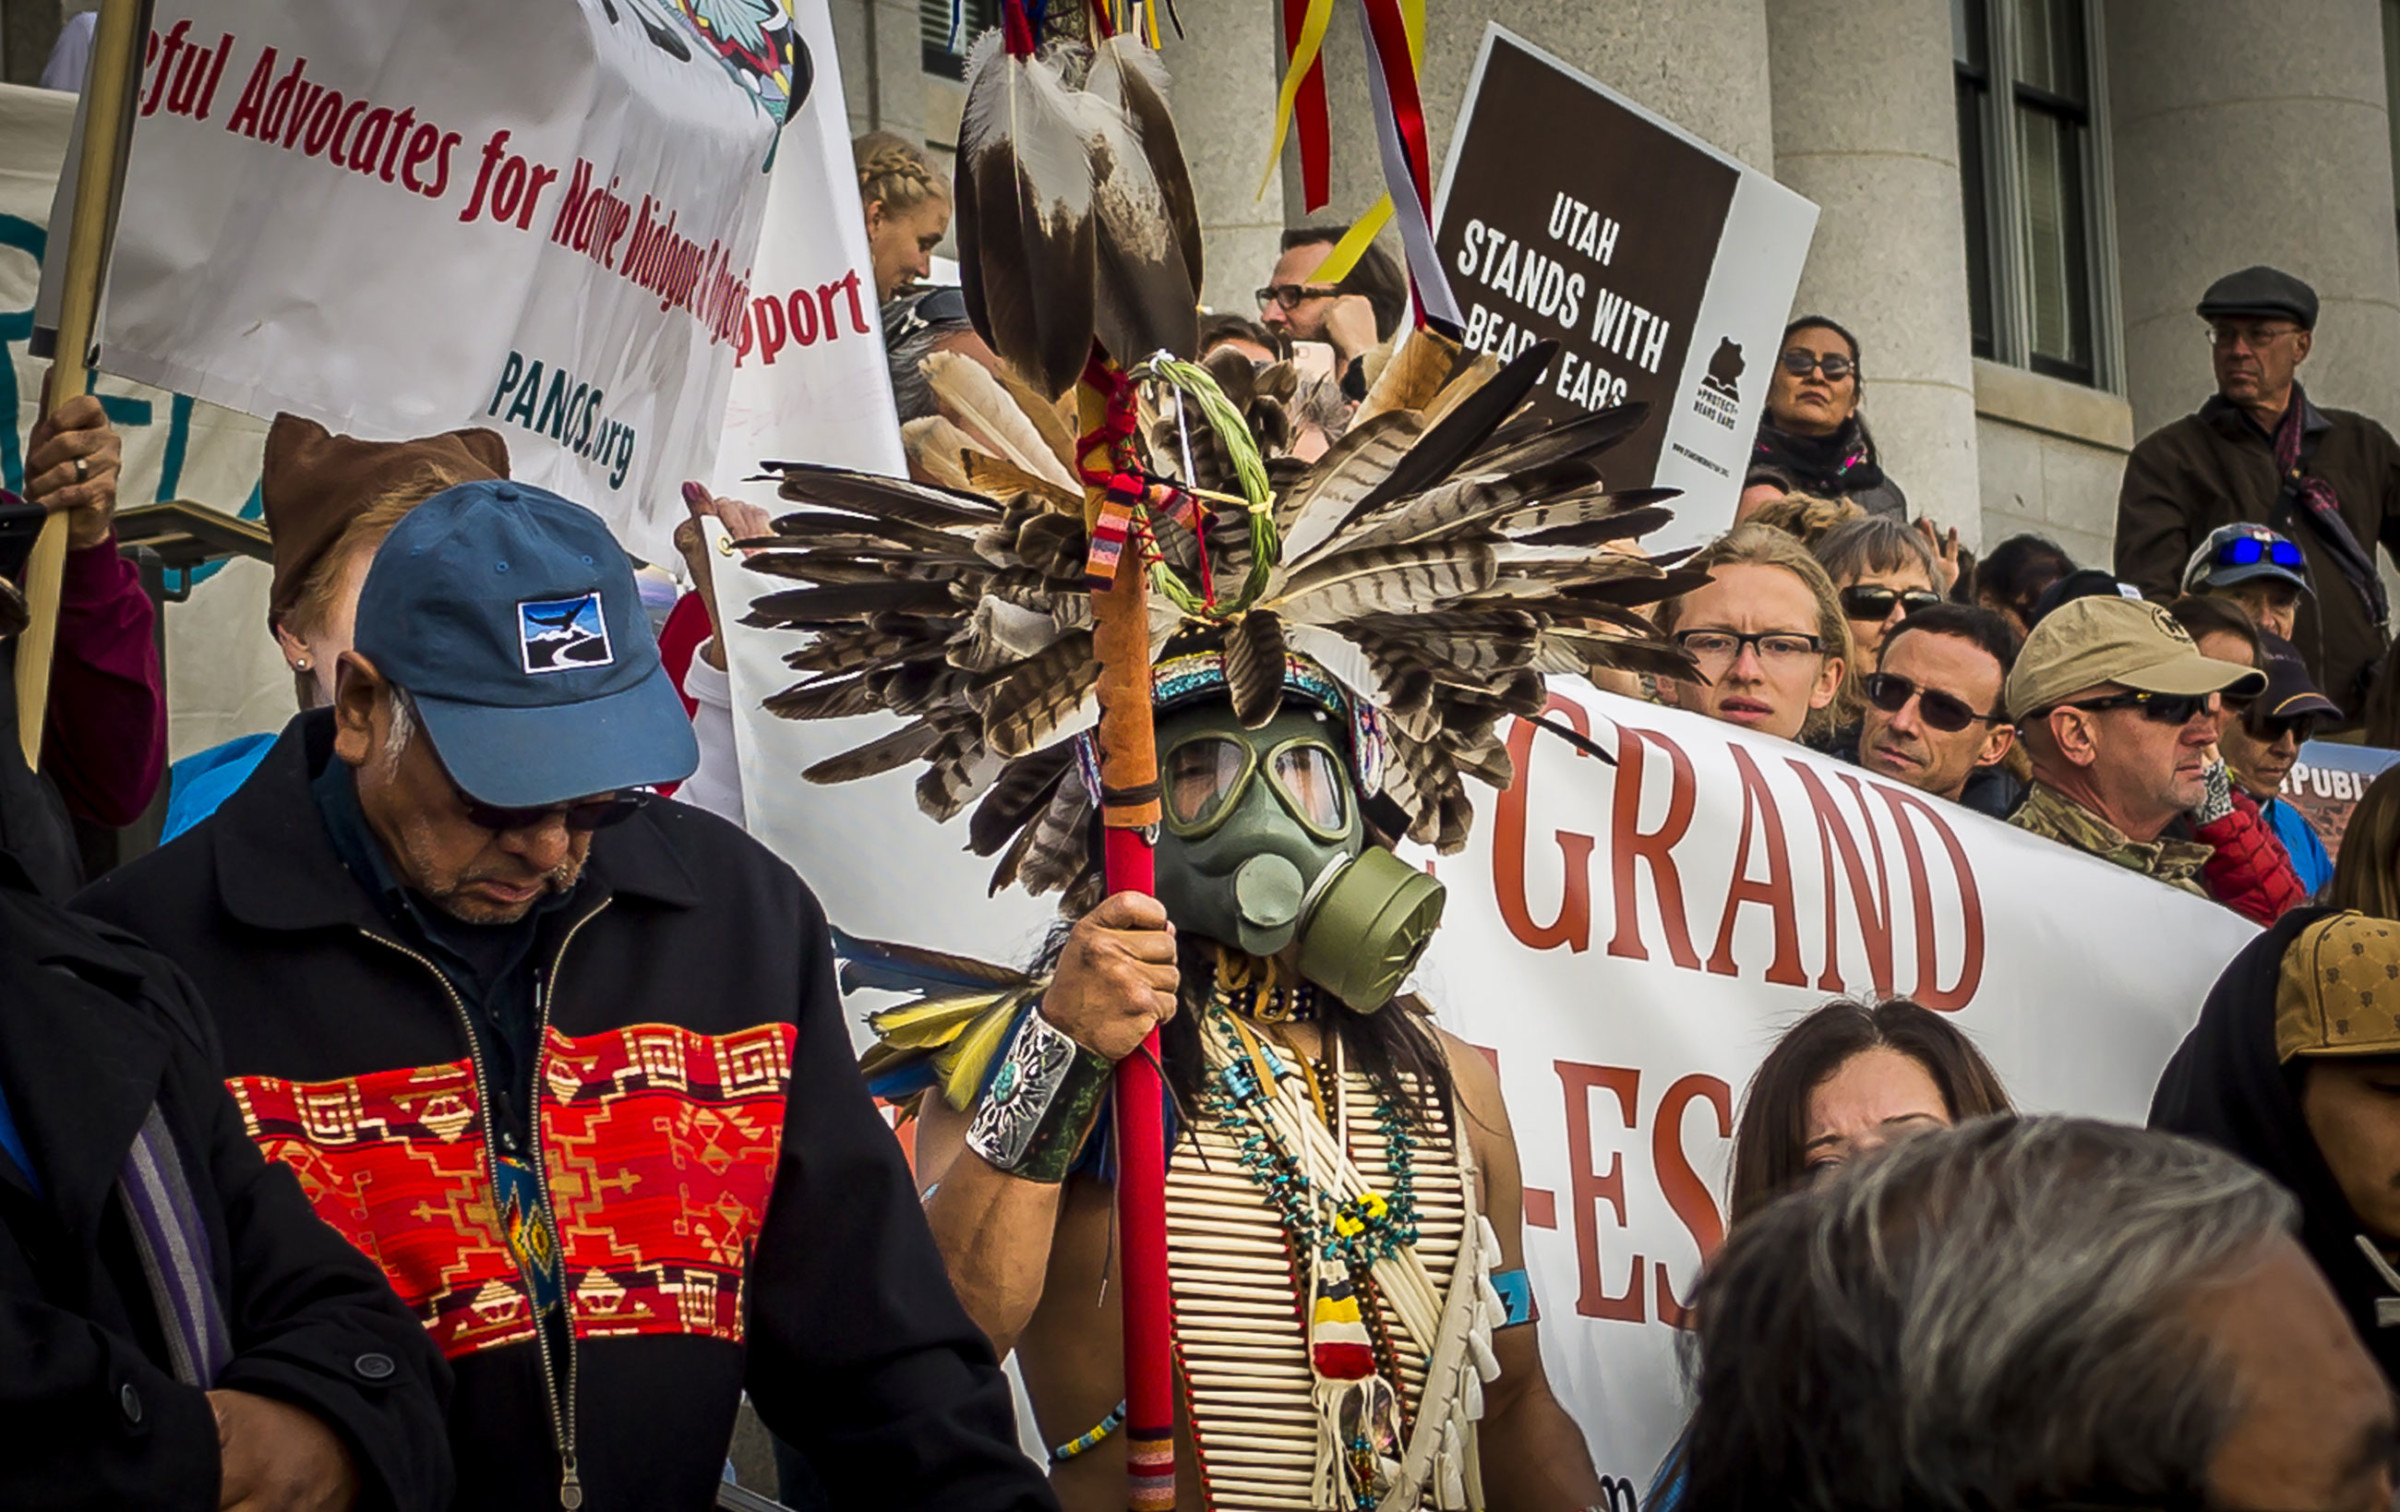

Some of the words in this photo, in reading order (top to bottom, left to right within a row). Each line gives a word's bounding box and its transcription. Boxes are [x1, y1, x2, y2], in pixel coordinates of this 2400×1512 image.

[226, 45, 462, 198] Advocates
[459, 129, 558, 231] for
[1457, 219, 1587, 329] STANDS
[1590, 288, 1670, 374] WITH
[1548, 191, 1620, 266] UTAH
[1491, 690, 1986, 1011] GRAND
